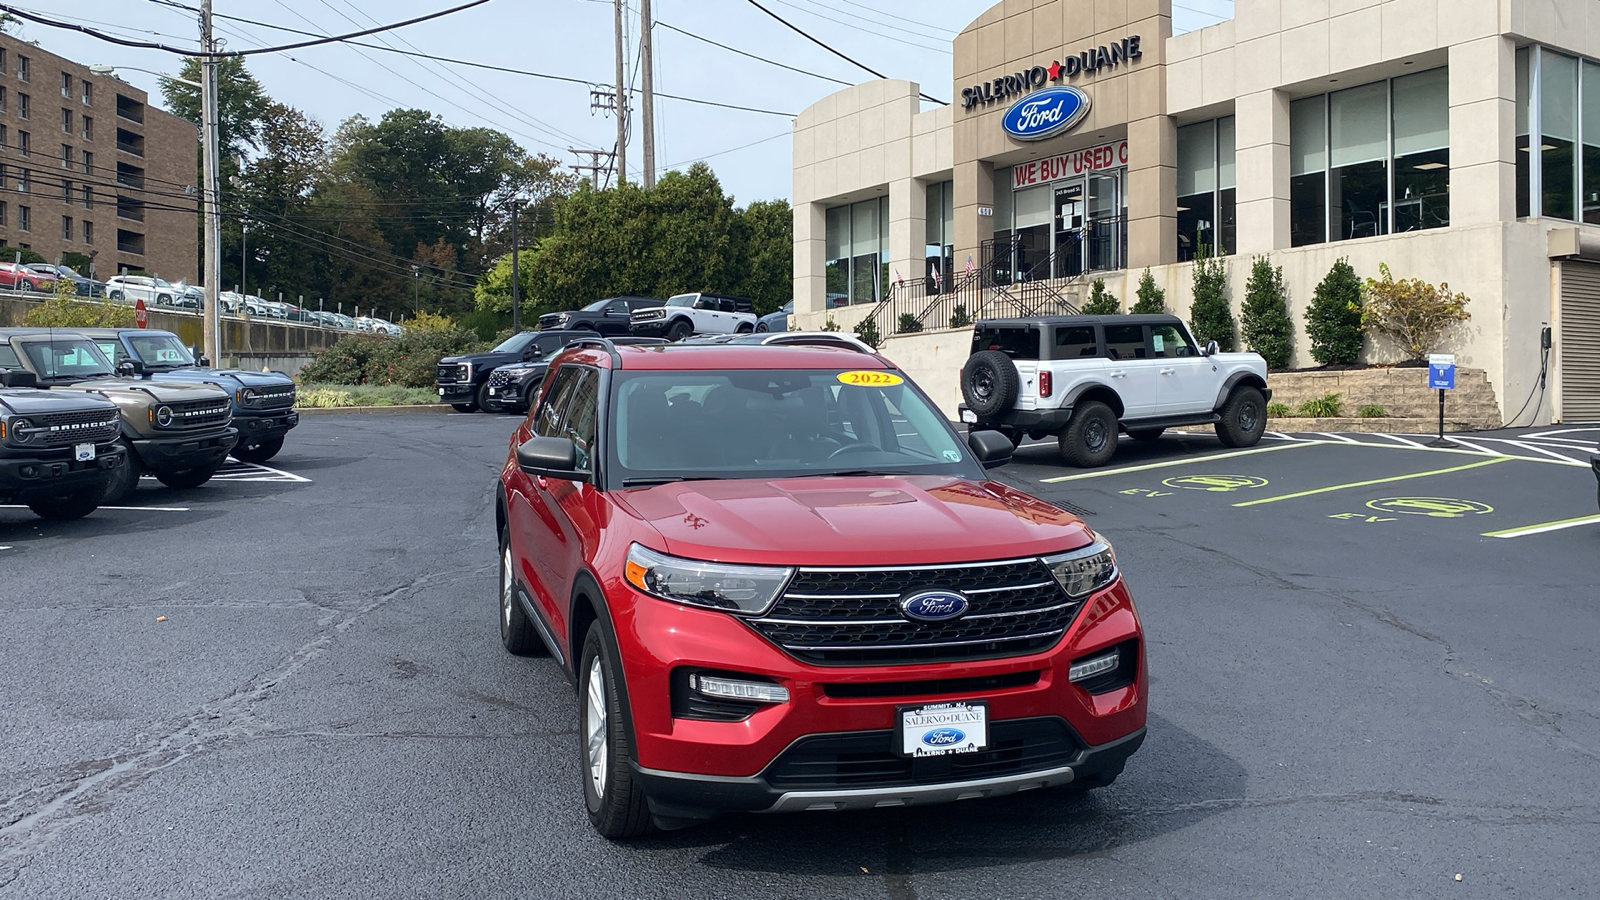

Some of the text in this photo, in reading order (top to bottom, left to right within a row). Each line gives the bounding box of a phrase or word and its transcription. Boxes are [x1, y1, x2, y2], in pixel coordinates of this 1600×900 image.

[961, 34, 1143, 108] SALERNO DUANE
[1016, 97, 1064, 131] Ford
[1014, 162, 1036, 186] WE
[1041, 154, 1070, 181] BUY
[1073, 145, 1114, 174] USED
[136, 309, 146, 322] STOP
[850, 374, 892, 384] 2022
[185, 407, 224, 417] BRONCO
[50, 421, 107, 431] BRONCO
[919, 597, 954, 614] Ford
[905, 711, 983, 726] SALERNO DUANE
[930, 731, 957, 744] Ford
[912, 746, 979, 758] SALERNO DUANE
